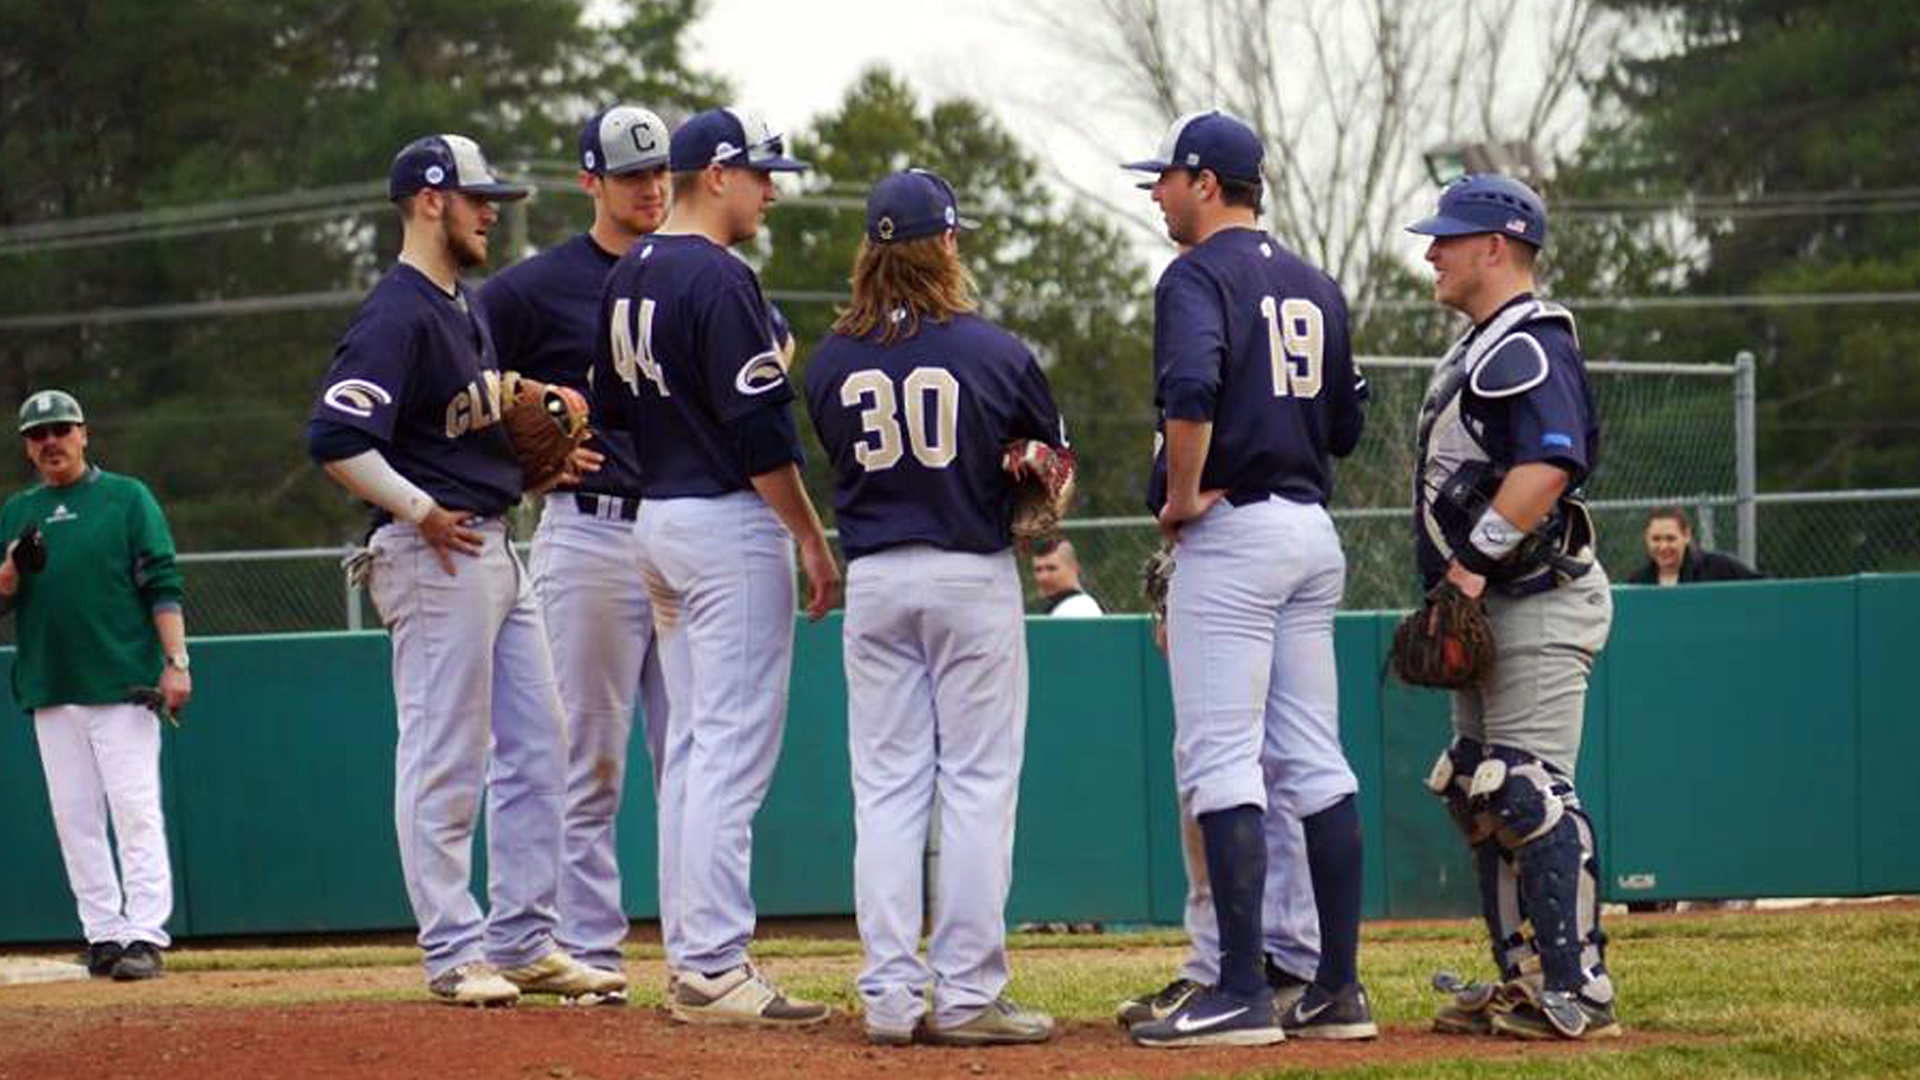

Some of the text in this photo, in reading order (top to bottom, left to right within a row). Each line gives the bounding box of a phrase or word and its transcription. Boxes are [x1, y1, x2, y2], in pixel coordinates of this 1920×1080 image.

[630, 122, 655, 152] C
[611, 298, 671, 397] 44
[1261, 296, 1324, 398] 19
[841, 366, 959, 472] 30
